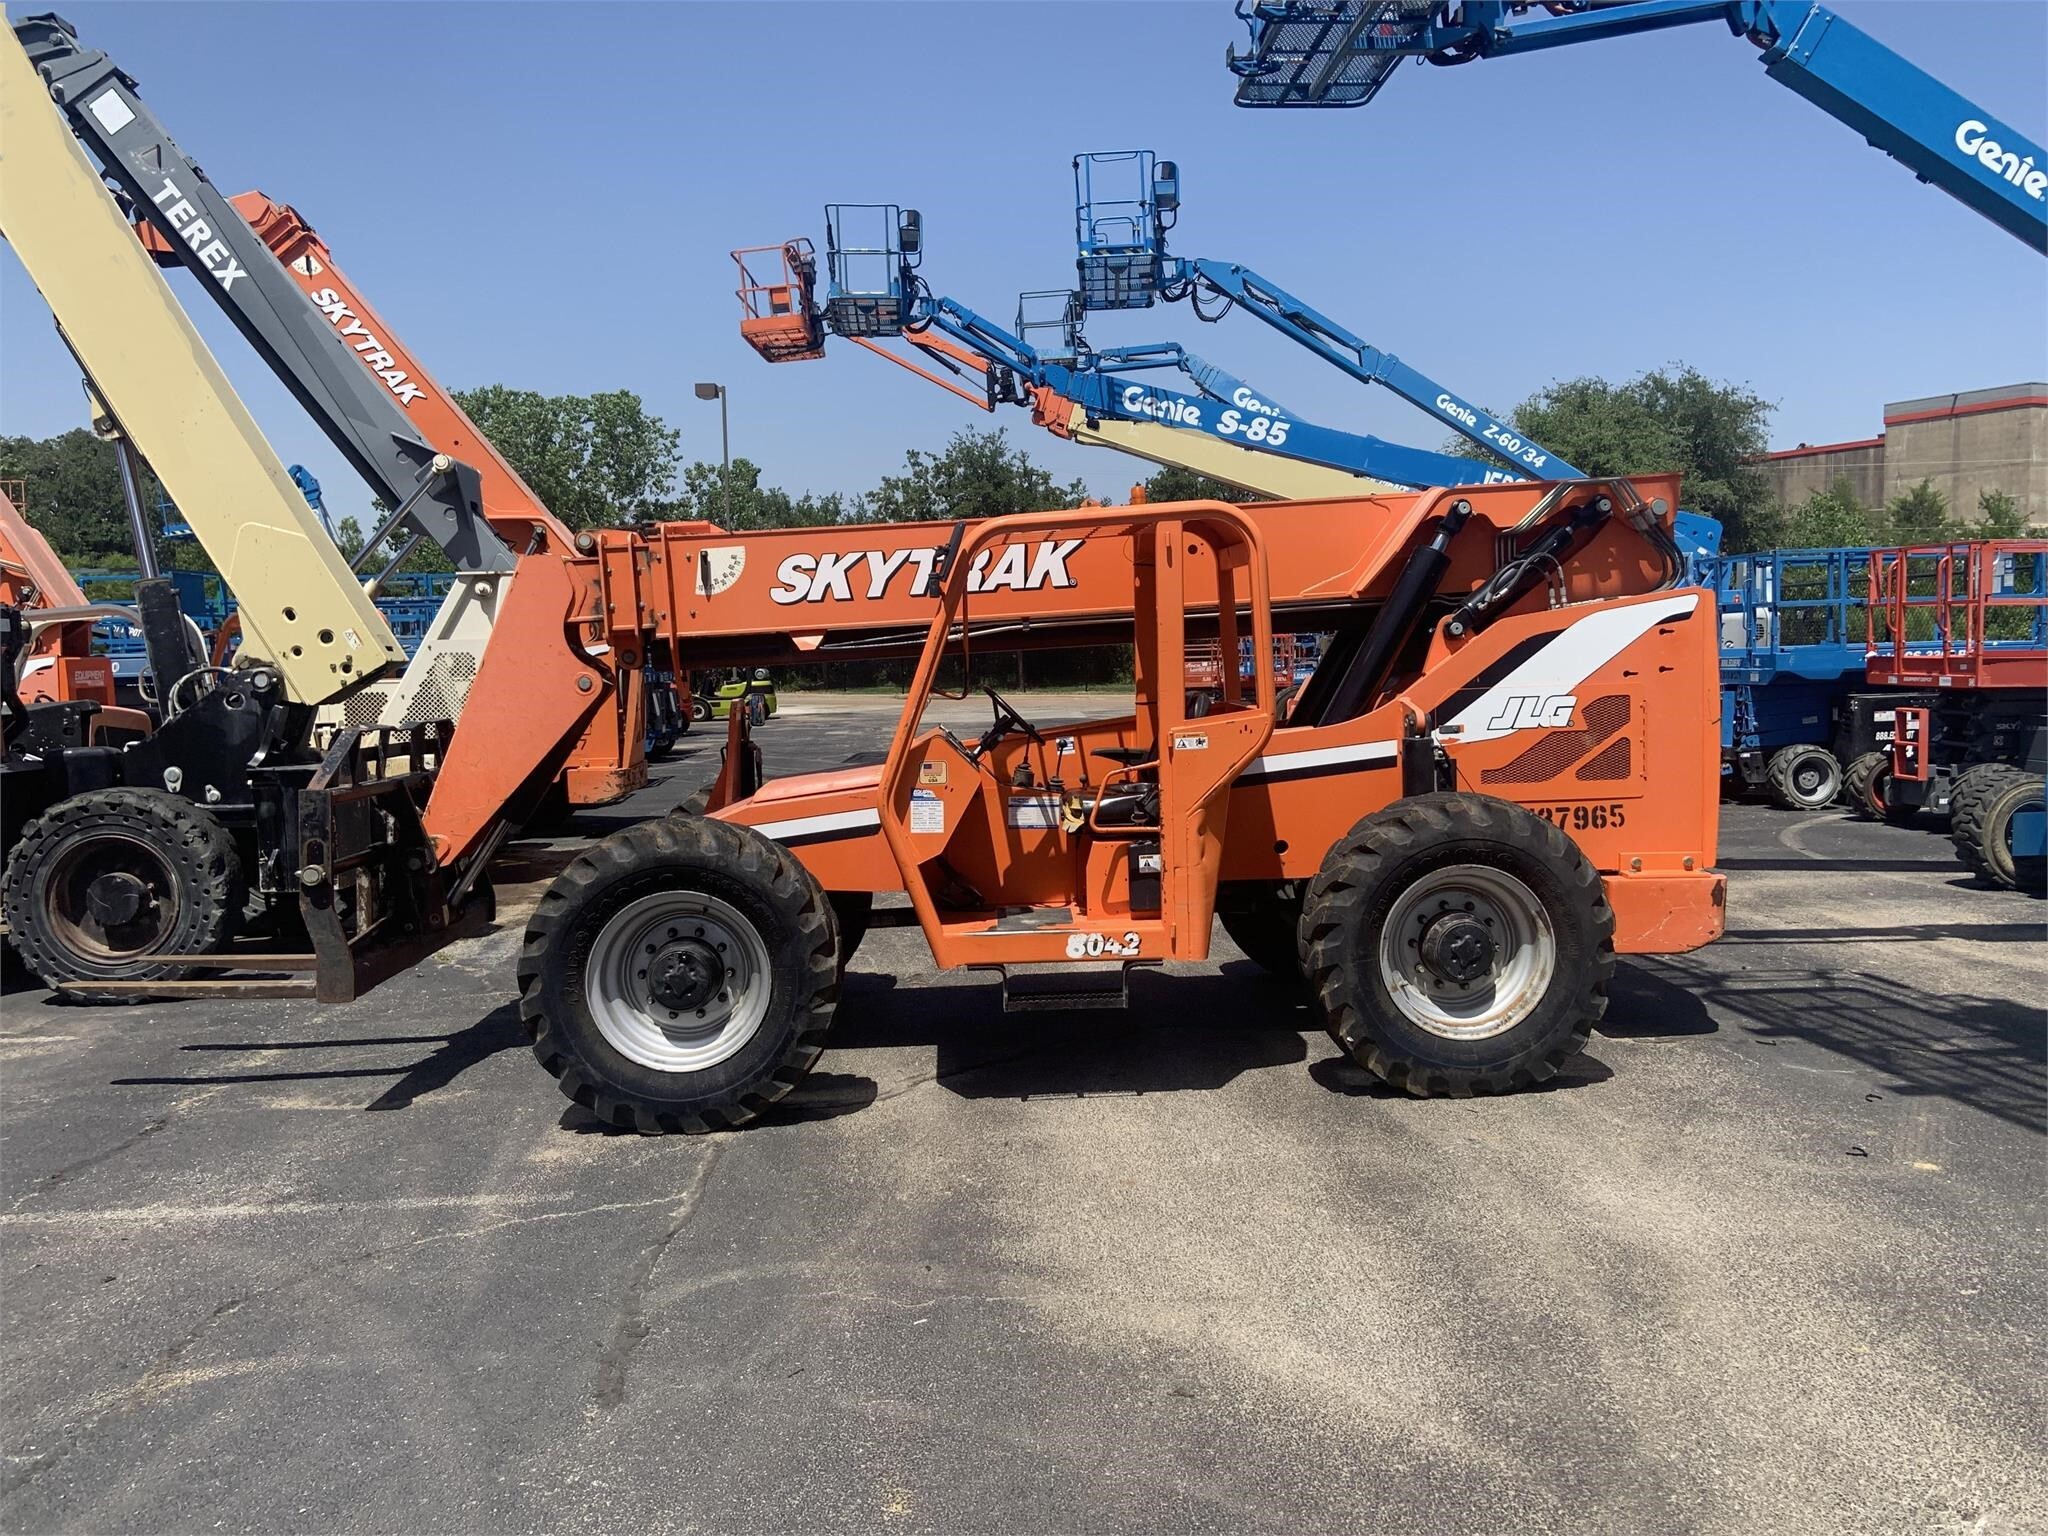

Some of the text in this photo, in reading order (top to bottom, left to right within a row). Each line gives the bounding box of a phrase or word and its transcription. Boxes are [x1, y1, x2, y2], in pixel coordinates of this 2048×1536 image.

[1955, 119, 2048, 200] Genie
[152, 177, 248, 291] TEREX
[311, 287, 428, 408] SKYTRAK
[1122, 386, 1291, 446] Genie S-85
[1233, 387, 1287, 419] Geni
[1436, 393, 1547, 468] Genie Z-60/34
[1487, 695, 1577, 730] JLG
[1529, 804, 1625, 830] 7965
[1065, 931, 1142, 959] 8042
